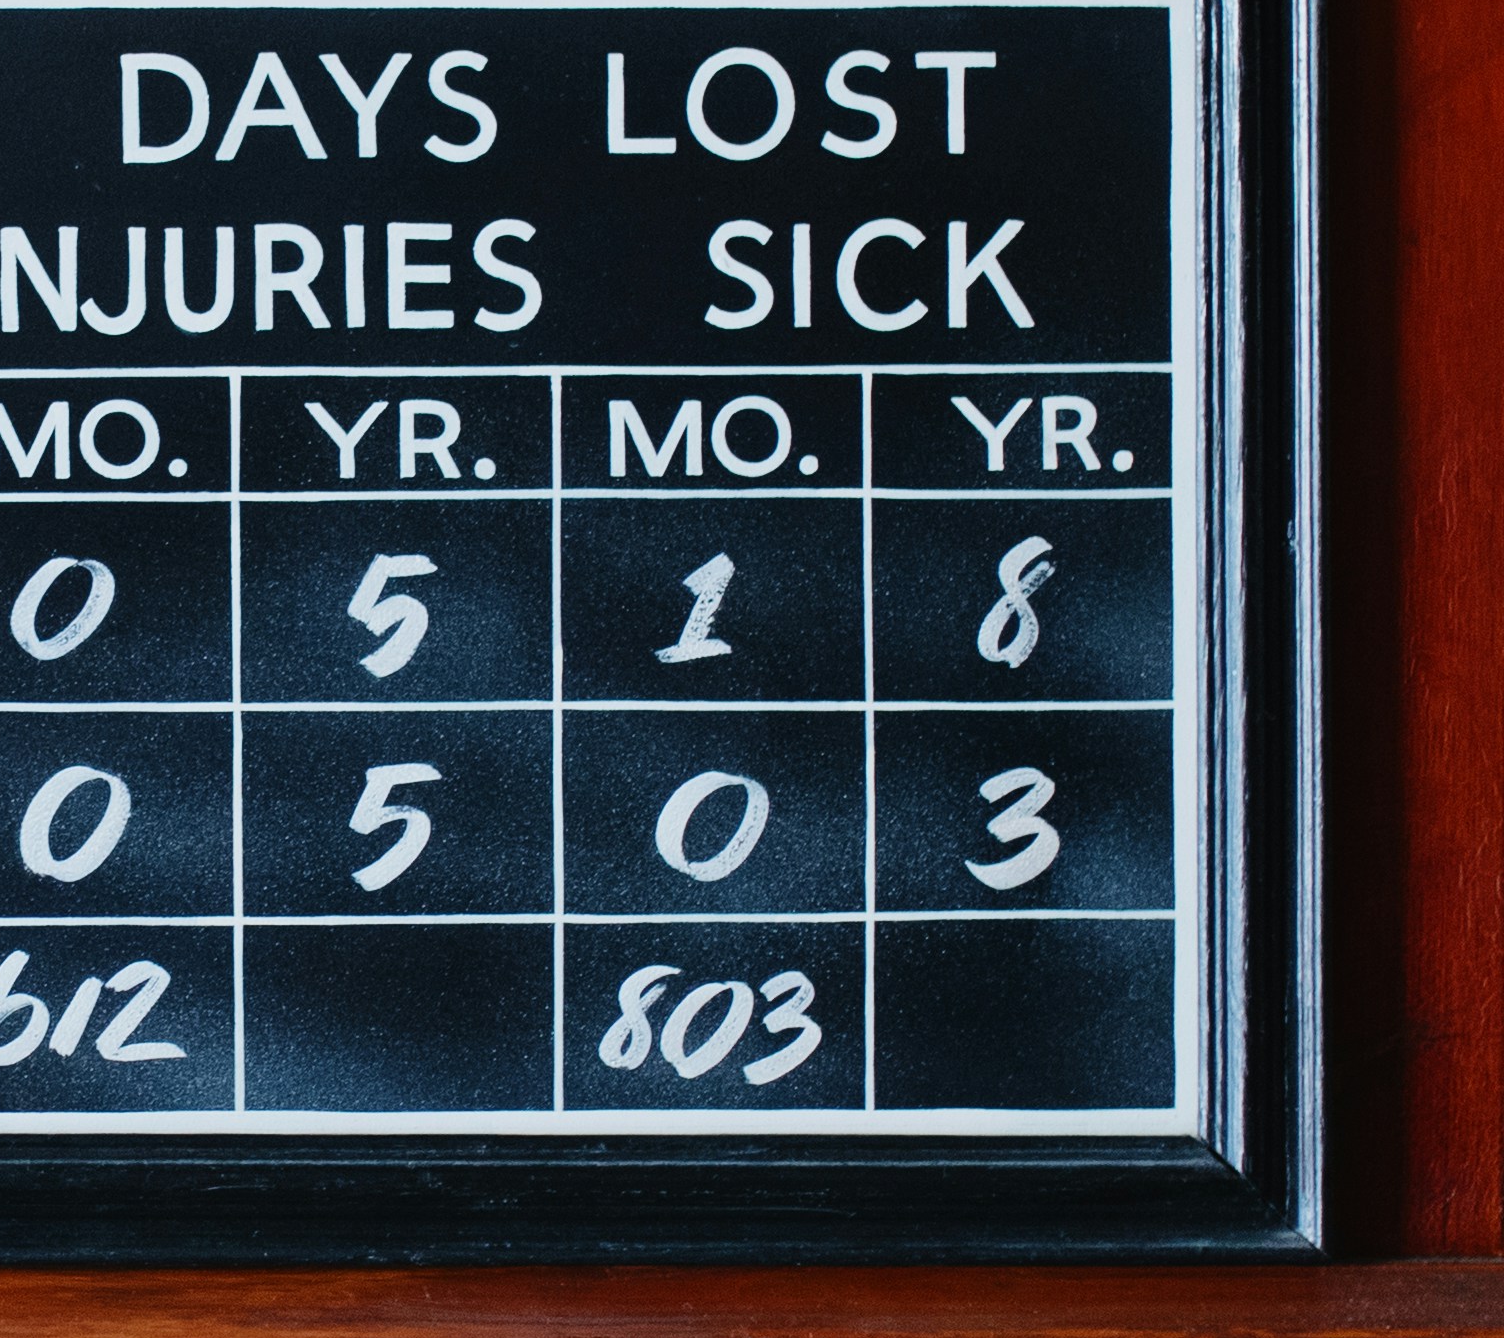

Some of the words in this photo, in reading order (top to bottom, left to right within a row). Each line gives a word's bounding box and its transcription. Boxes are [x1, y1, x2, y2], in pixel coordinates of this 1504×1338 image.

[121, 51, 498, 164] DAYS
[608, 48, 997, 161] LOST
[705, 219, 1035, 332] SICK
[305, 400, 497, 480] YR.
[609, 396, 820, 478] MO.
[951, 396, 1134, 478] YR.
[10, 557, 116, 661] 0
[347, 553, 439, 678] 5
[654, 552, 737, 664] 1
[976, 535, 1056, 669] 8
[19, 765, 132, 883] 0
[348, 762, 443, 892] 5
[654, 770, 770, 882] 0
[964, 767, 1060, 890] 3
[598, 964, 822, 1086] 803
